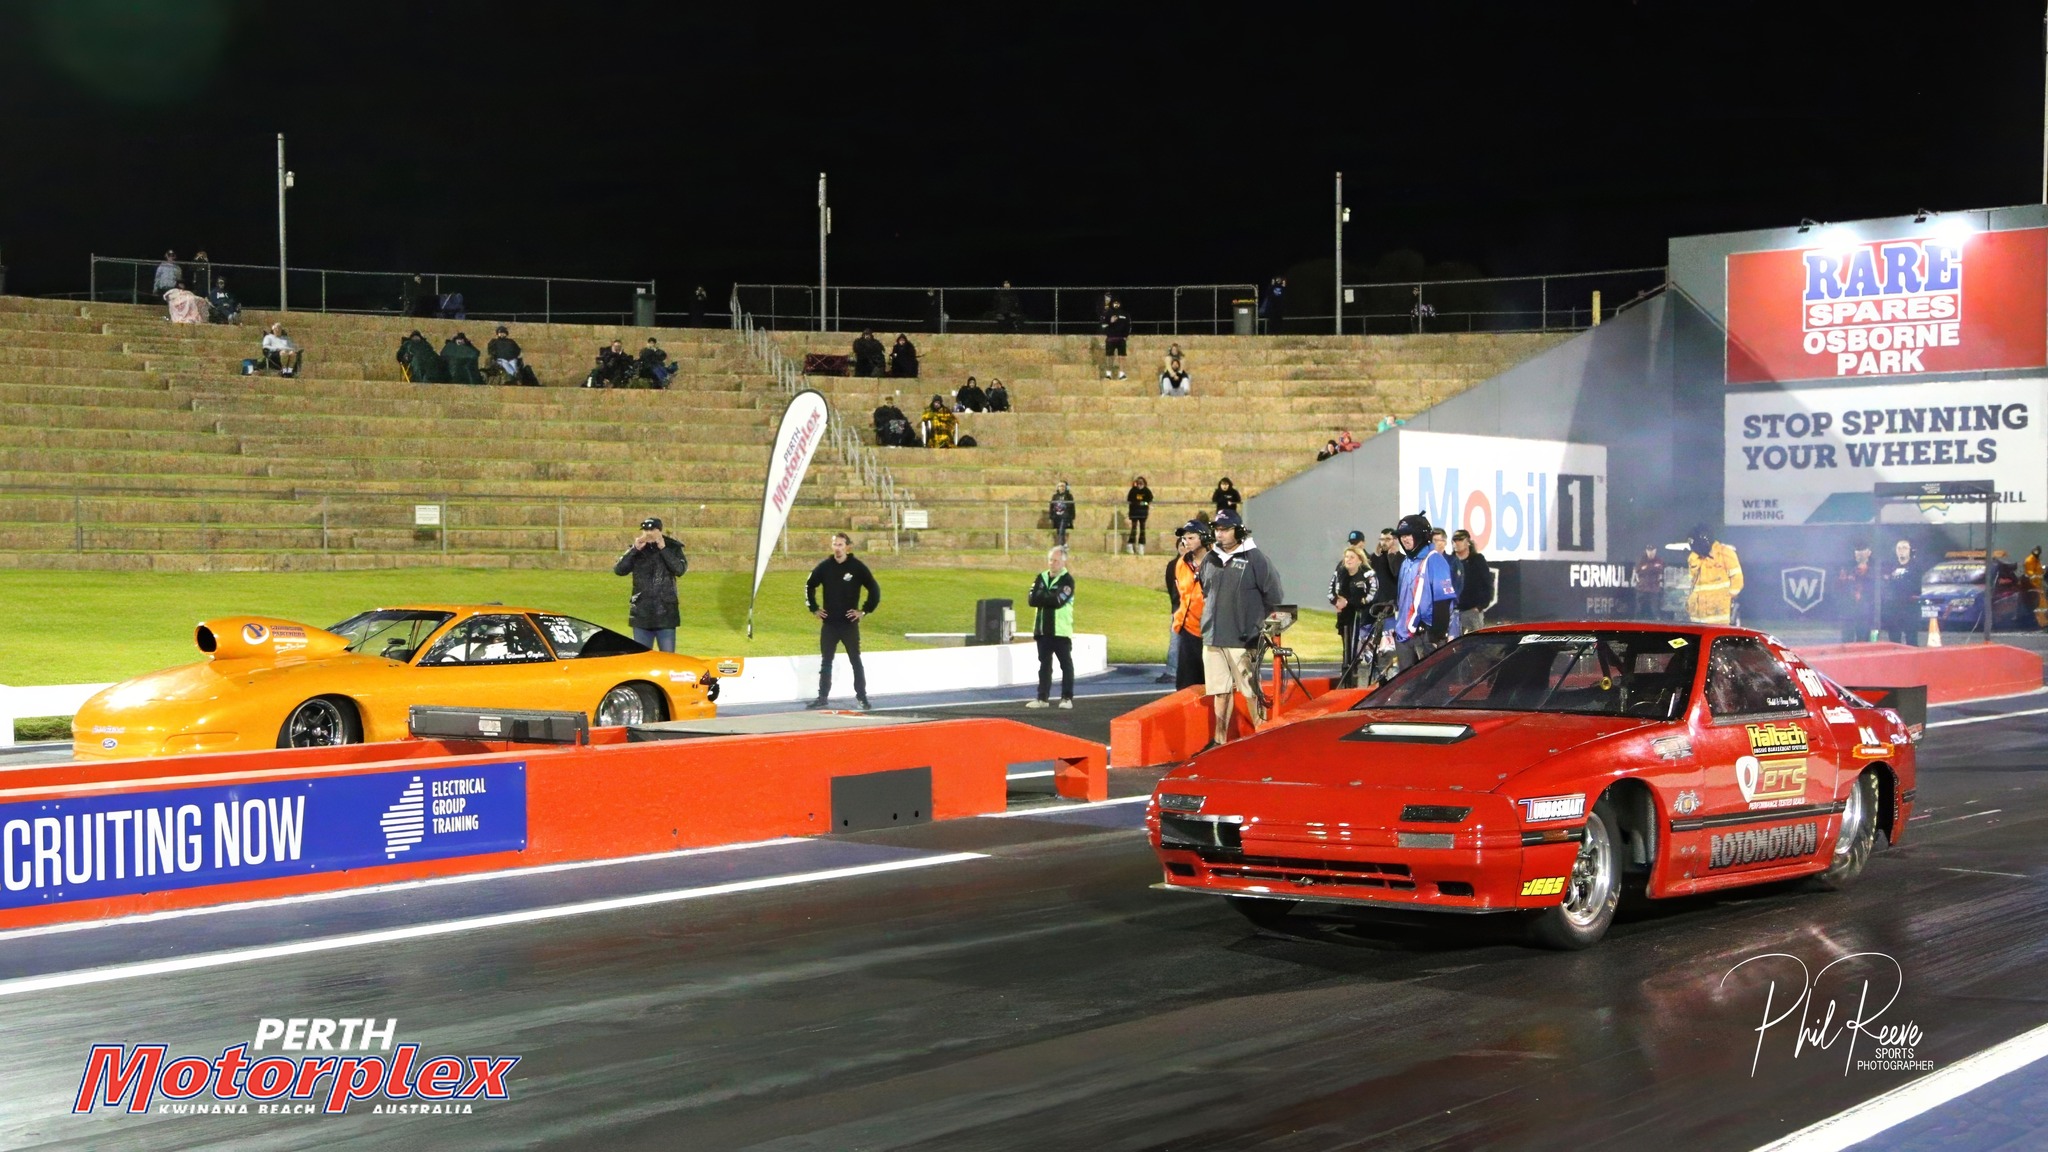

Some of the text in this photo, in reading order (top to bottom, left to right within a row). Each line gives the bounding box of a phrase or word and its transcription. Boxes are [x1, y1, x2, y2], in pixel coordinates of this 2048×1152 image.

[1805, 245, 1959, 300] RARE
[1808, 295, 1956, 327] SPARES
[1803, 322, 1960, 355] OSBORNE
[1837, 348, 1925, 376] PARK
[1743, 403, 2028, 439] STOP SPINNING
[771, 407, 821, 513] Motorplex
[783, 426, 802, 464] PERTH
[1742, 438, 1997, 471] YOUR WHEELS
[1418, 466, 1548, 552] Mobil
[1742, 498, 1779, 509] WE'RE
[1742, 510, 1785, 521] HIRING
[550, 625, 578, 643] 153
[1747, 724, 1807, 747] Haltech
[432, 777, 487, 798] ELECTRICAL
[1762, 766, 1807, 793] PTS
[432, 797, 466, 816] GROUP
[432, 814, 479, 834] TRAINING
[3, 795, 306, 891] CRUITING NOW
[1708, 821, 1817, 870] ROTOMOTION
[1521, 876, 1566, 896] JEGS
